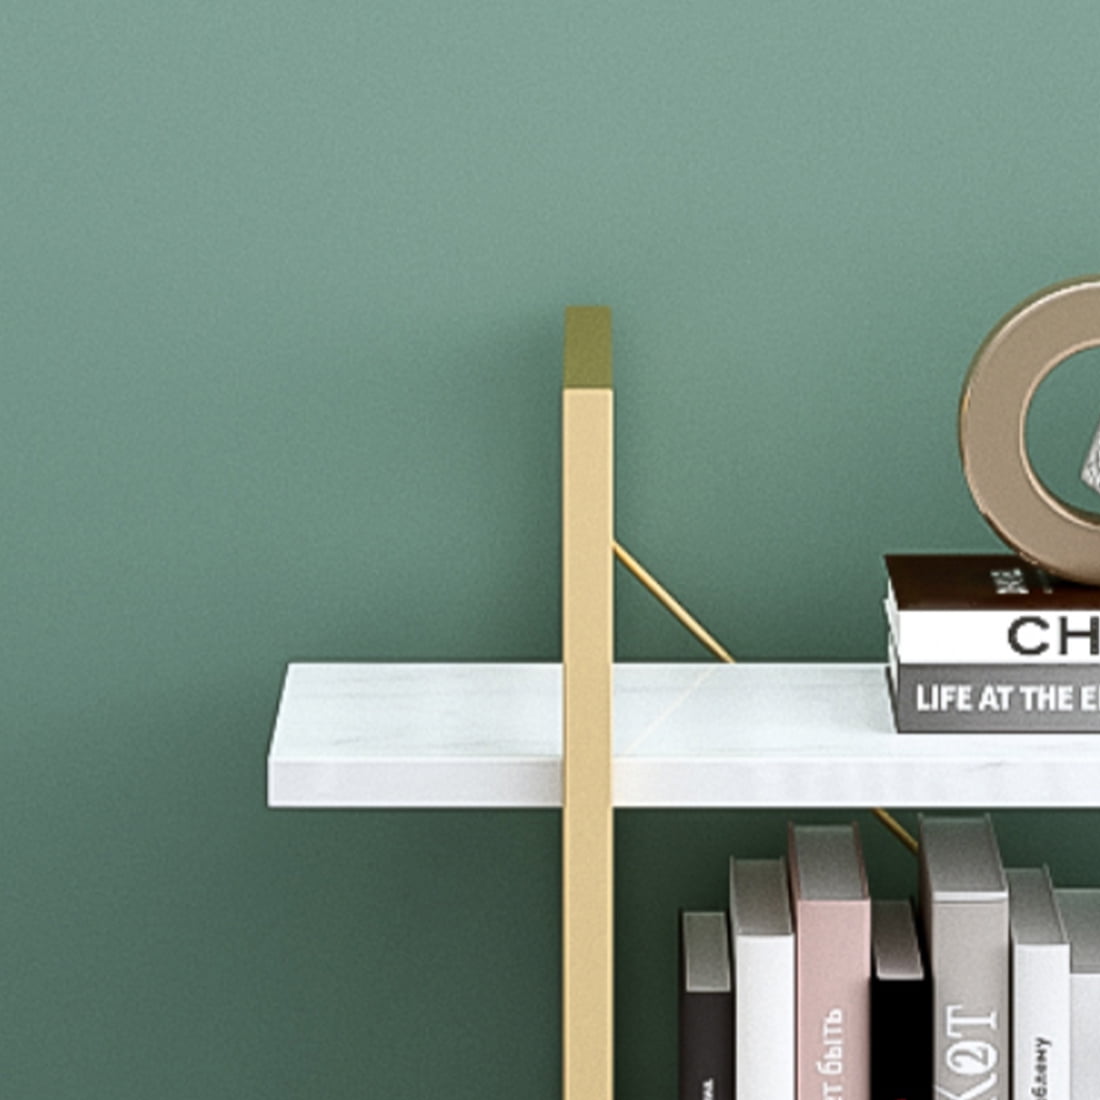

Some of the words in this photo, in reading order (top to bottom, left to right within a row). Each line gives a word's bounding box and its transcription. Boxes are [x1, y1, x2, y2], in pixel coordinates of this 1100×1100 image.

[914, 684, 975, 713] LIFE
[980, 684, 1018, 713] AT
[1019, 684, 1079, 713] THE
[815, 1008, 843, 1076] быть
